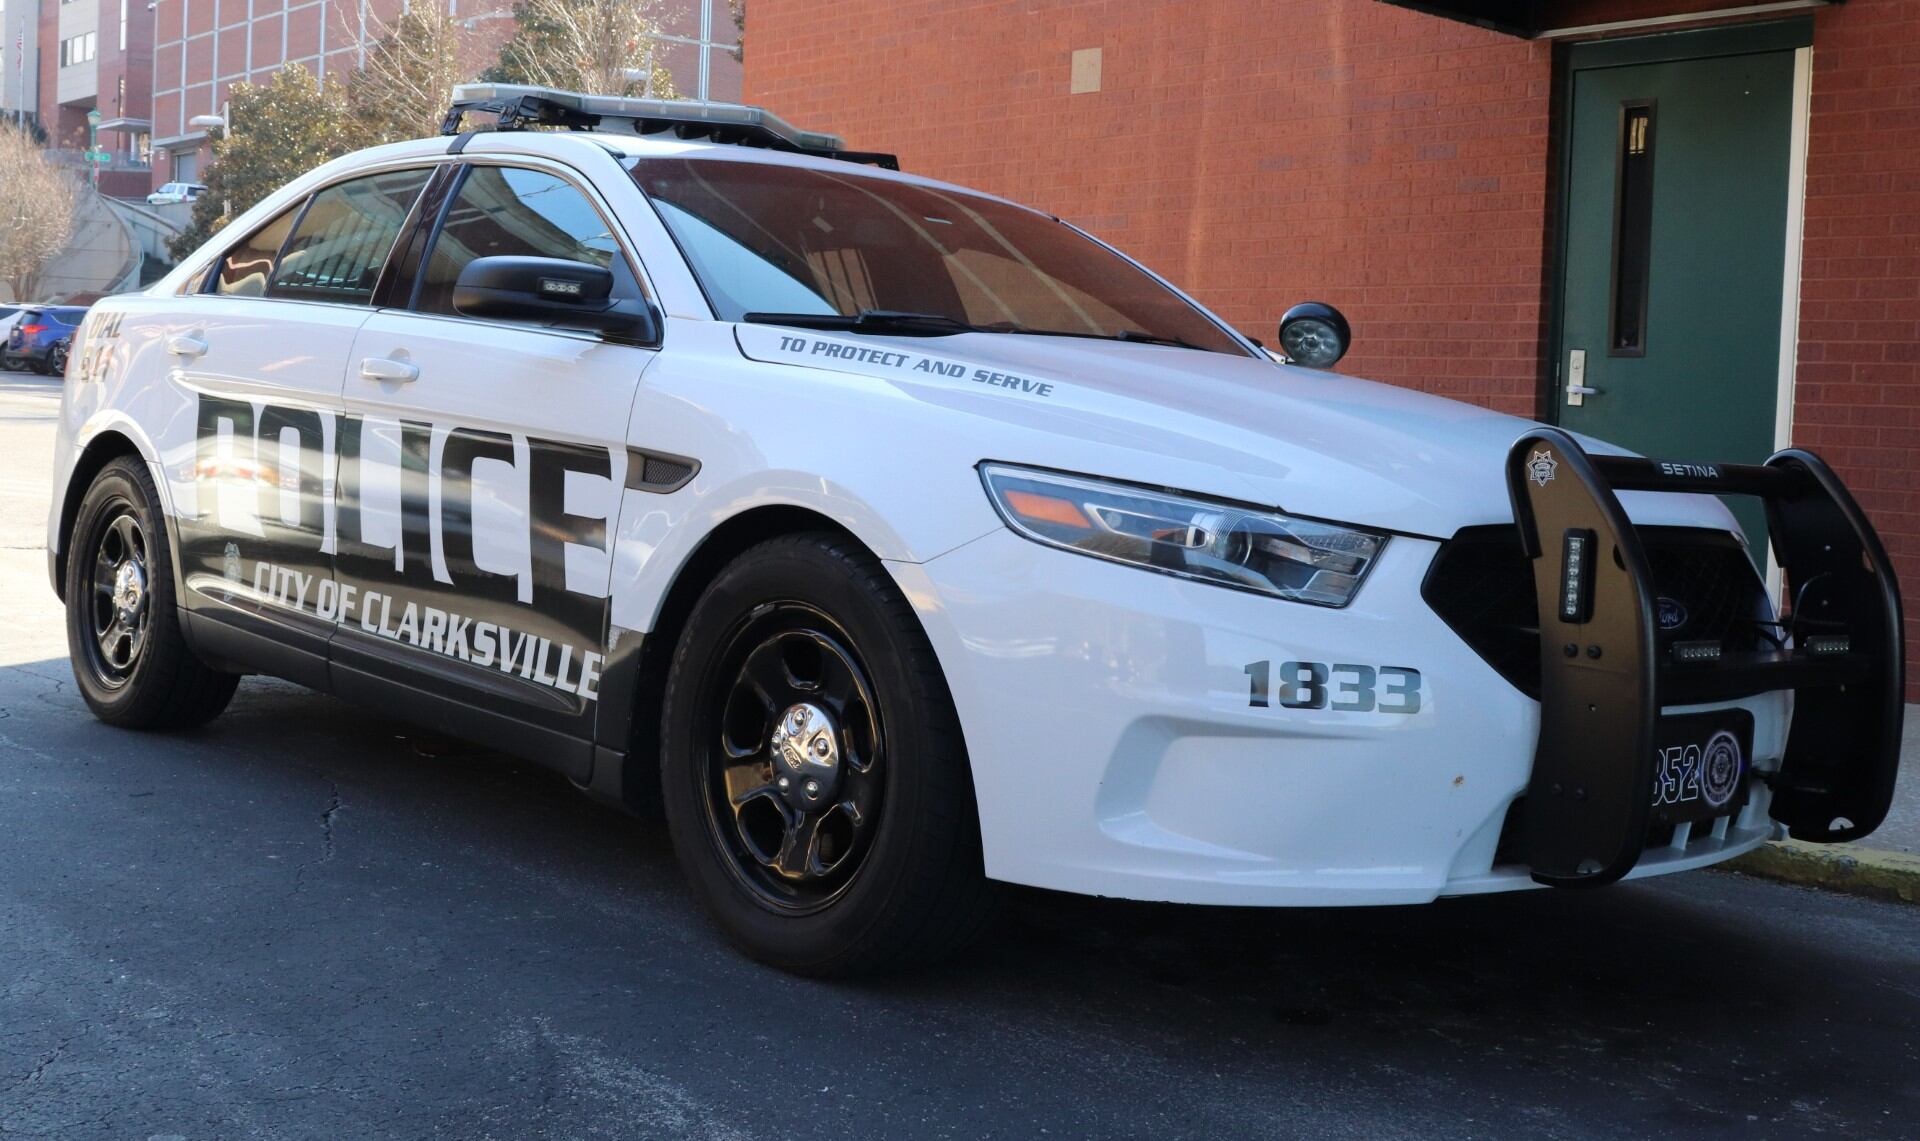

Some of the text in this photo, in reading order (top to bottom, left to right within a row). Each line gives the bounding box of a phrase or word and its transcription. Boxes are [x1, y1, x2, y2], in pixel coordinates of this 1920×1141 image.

[780, 336, 1054, 397] TO PROTECT AND SERVE
[194, 392, 613, 604] POLICE
[1661, 462, 1719, 478] SETINA
[253, 561, 313, 611] CITY
[316, 578, 357, 624] OF
[361, 590, 606, 701] CLARKSVILLE
[1244, 660, 1422, 715] 1833
